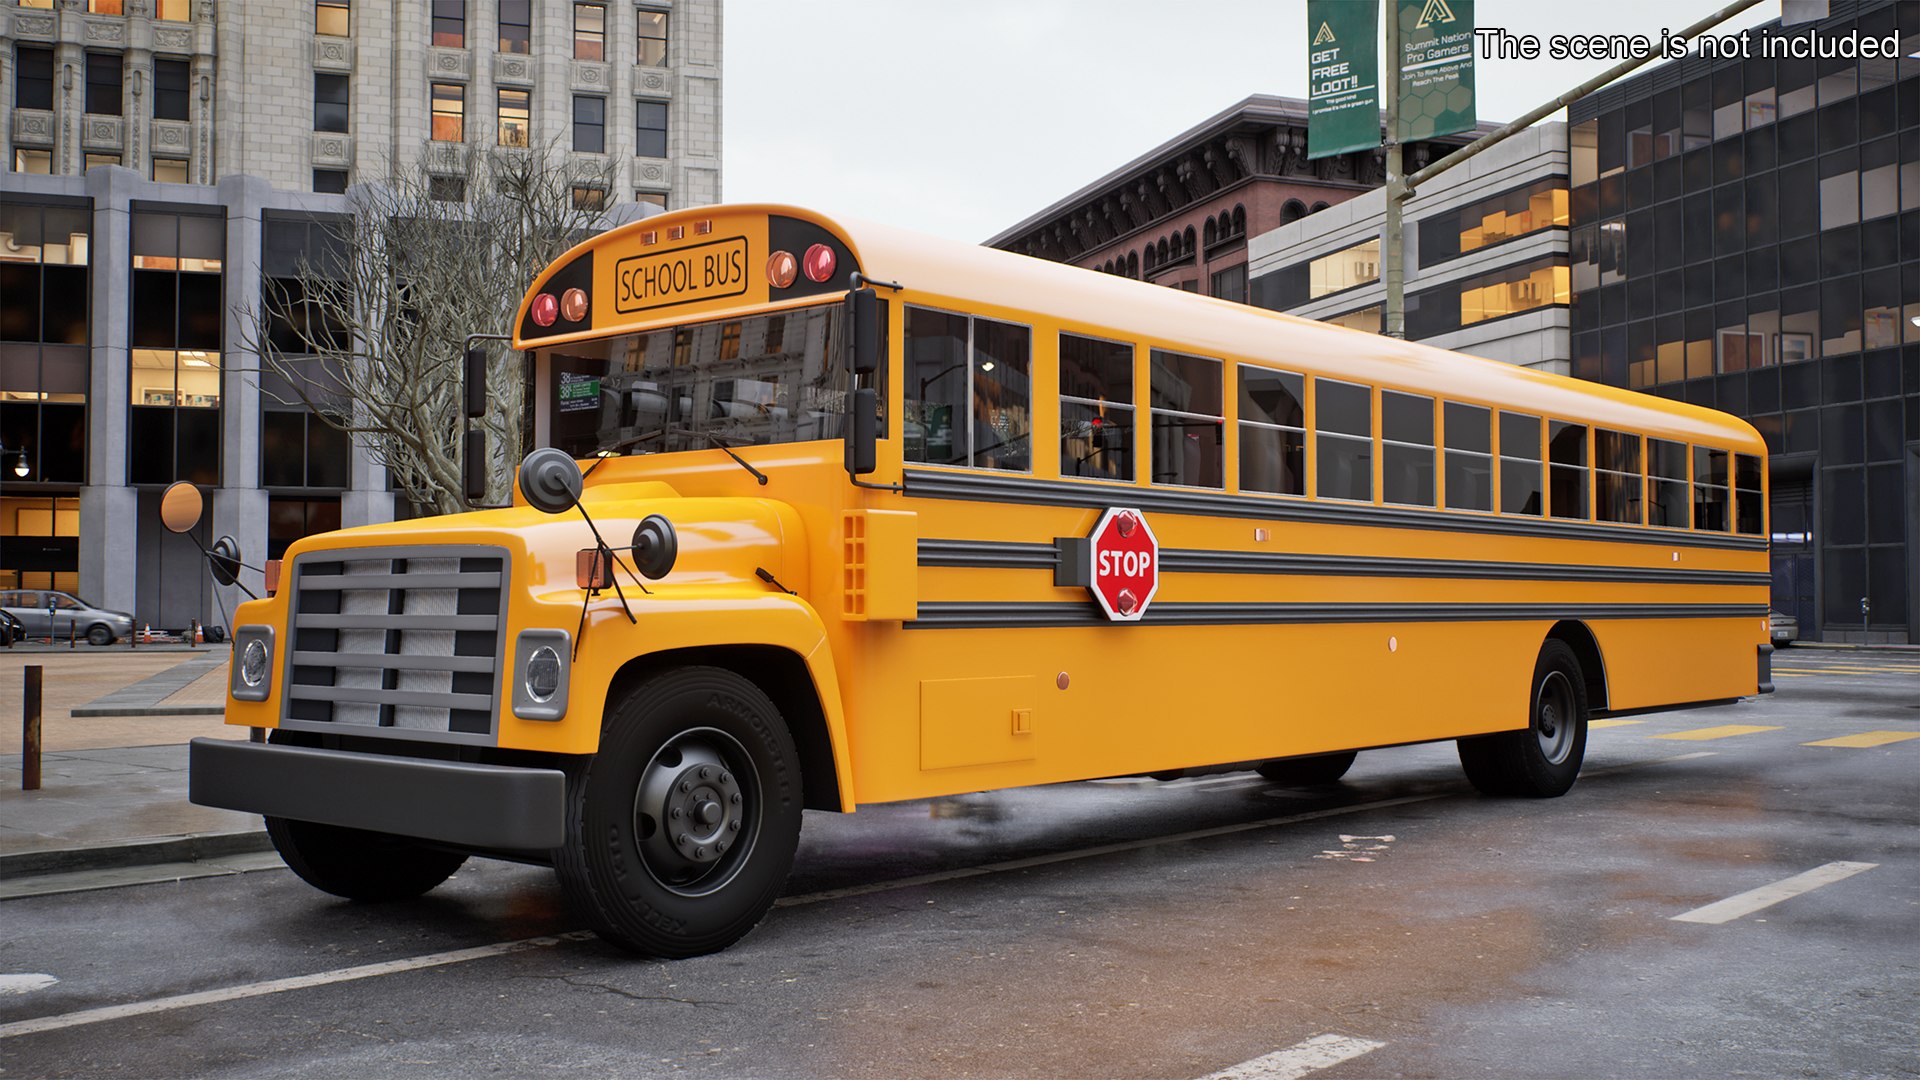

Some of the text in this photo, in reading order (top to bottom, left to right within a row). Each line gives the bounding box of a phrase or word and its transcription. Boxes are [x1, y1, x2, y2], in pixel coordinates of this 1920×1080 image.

[1405, 32, 1472, 52] Summit Nation
[1311, 47, 1340, 64] GET
[1406, 43, 1469, 64] Pro Gamers
[1312, 62, 1350, 80] FREE
[1402, 72, 1416, 81] Join
[1416, 70, 1424, 78] To
[1439, 64, 1459, 73] Above
[1459, 61, 1473, 69] And
[1312, 75, 1358, 96] LOOT!!
[621, 249, 741, 301] SCHOOL BUS
[1099, 549, 1151, 578] STOP
[628, 896, 688, 936] KELLY
